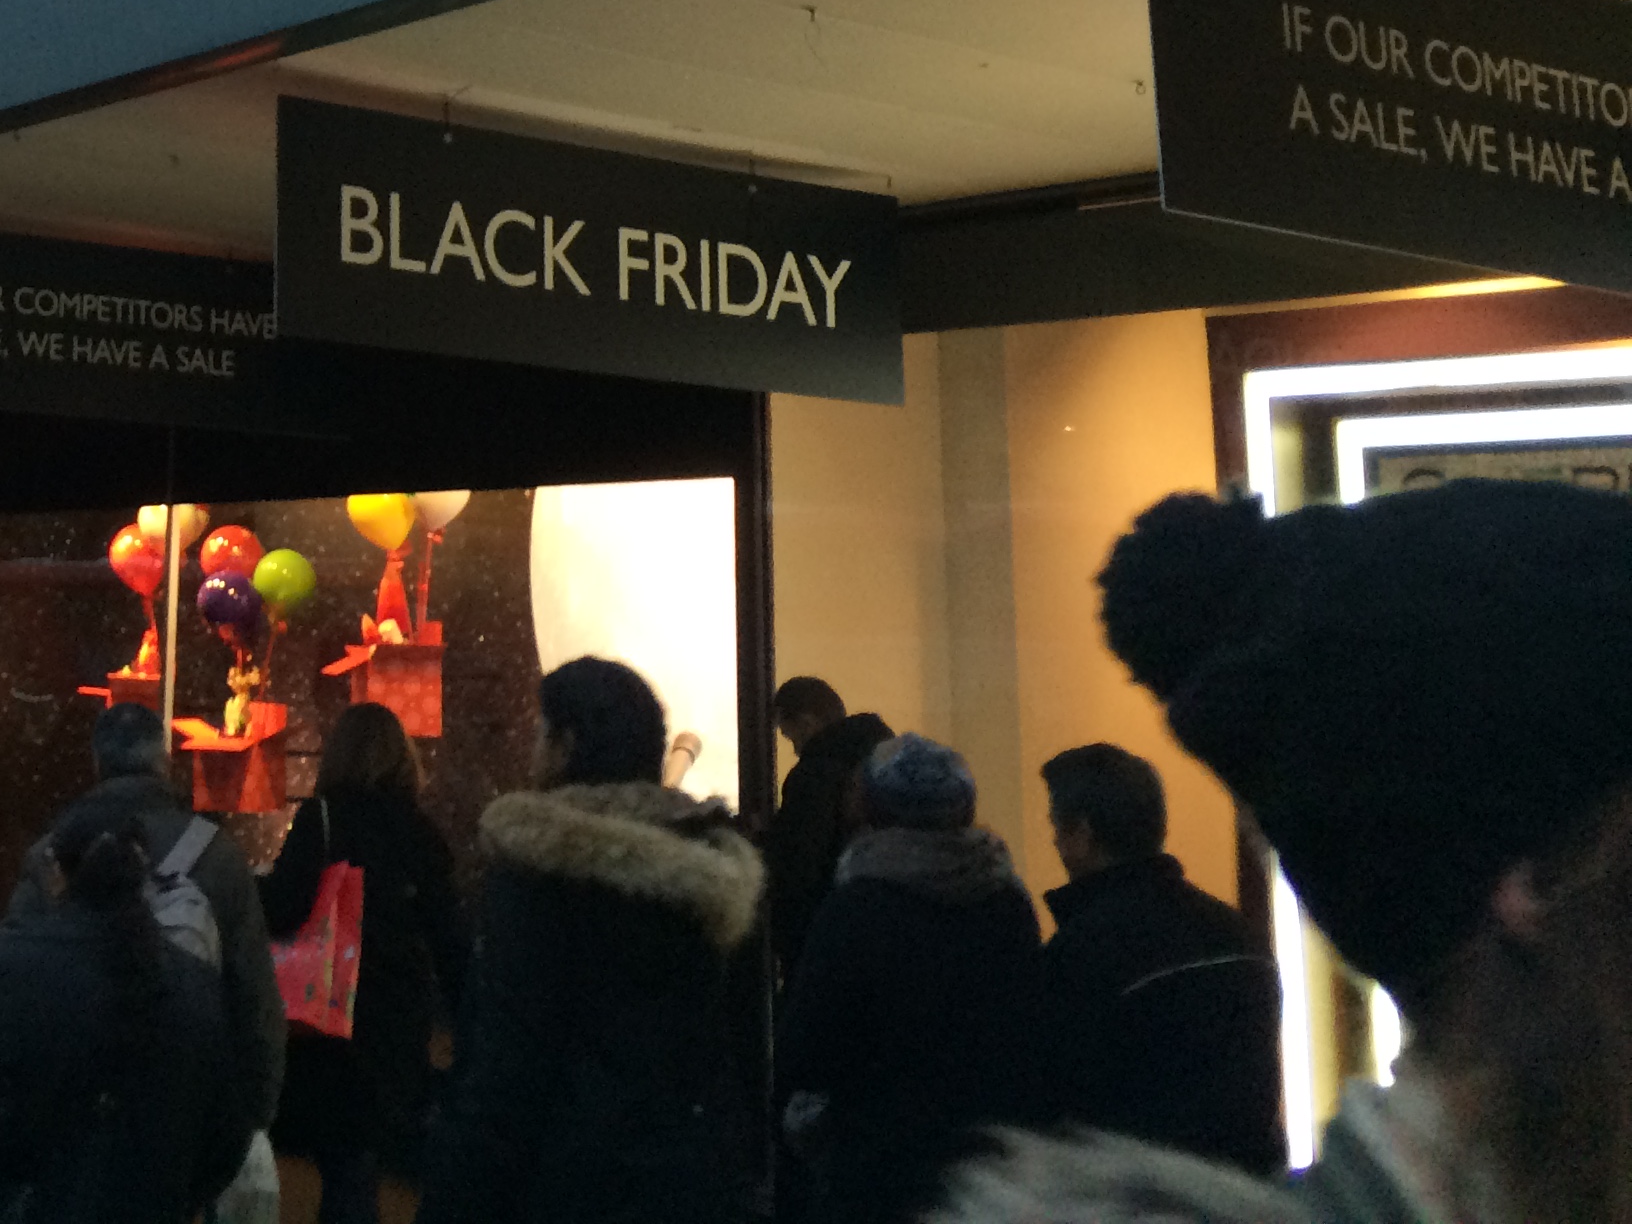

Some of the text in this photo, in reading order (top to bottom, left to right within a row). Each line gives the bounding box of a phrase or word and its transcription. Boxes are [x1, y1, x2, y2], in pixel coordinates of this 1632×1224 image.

[1282, 2, 1313, 52] IF
[1325, 15, 1415, 78] OUR
[1289, 84, 1632, 203] A SALE, WE HAVE A
[339, 183, 852, 328] BLACK FRIDAY
[13, 285, 203, 333] COMPETITORS
[210, 307, 277, 340] HAVE
[17, 329, 65, 361] WE
[72, 335, 143, 369] HAVE
[148, 342, 169, 372] A
[176, 345, 237, 377] SALE
